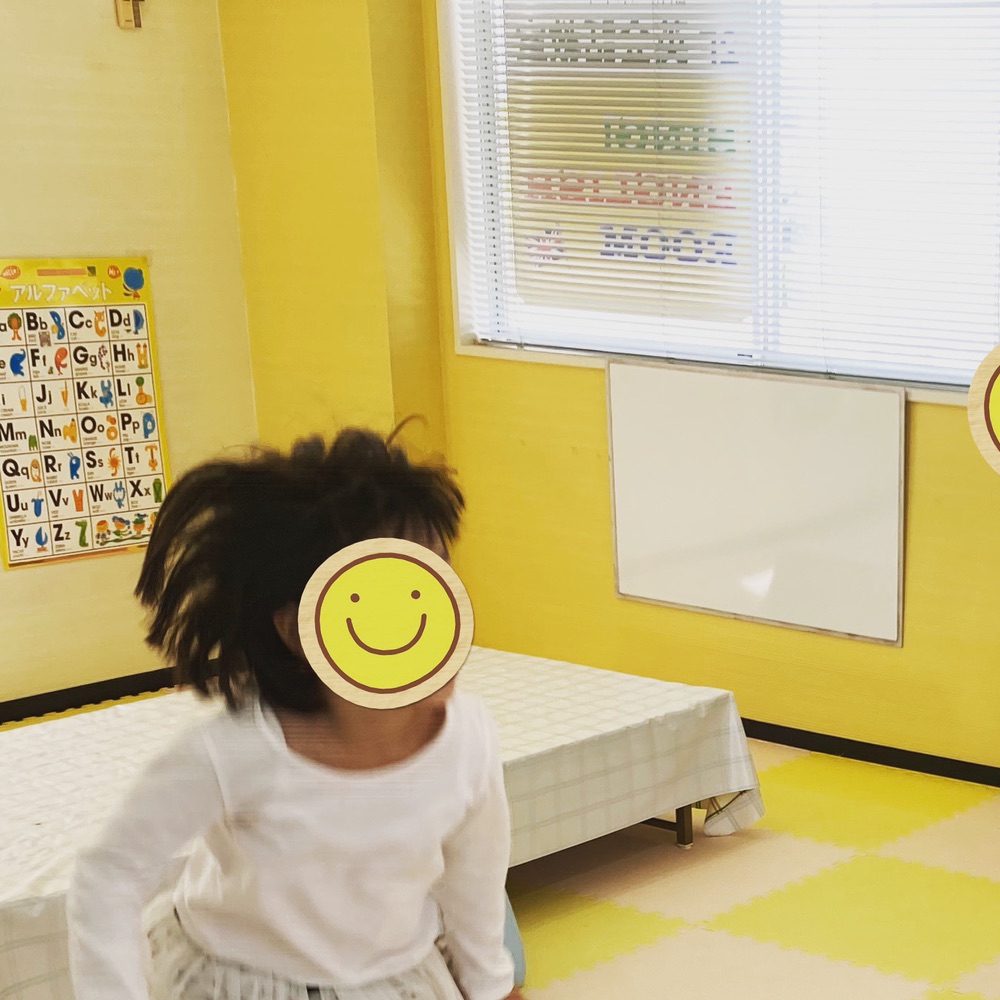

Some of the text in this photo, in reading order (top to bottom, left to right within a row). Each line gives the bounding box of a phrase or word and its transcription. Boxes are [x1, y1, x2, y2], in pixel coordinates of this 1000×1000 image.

[9, 282, 112, 303] アルファベット
[25, 312, 48, 331] Bb
[68, 310, 93, 329] Cc
[109, 309, 131, 327] Dd
[30, 348, 47, 367] Ff
[73, 346, 97, 367] Gg
[113, 344, 135, 362] Hh
[36, 384, 52, 405] Jj
[76, 381, 98, 400] Kk
[0, 413, 140, 442] Mm Nn Oo Pp
[2, 458, 30, 480] Qq
[44, 455, 63, 473] Rr
[85, 450, 104, 469] Ss
[124, 446, 140, 464] Tt
[6, 479, 152, 513] Uu Vv Ww Xx
[10, 523, 71, 548] Yy Zz
